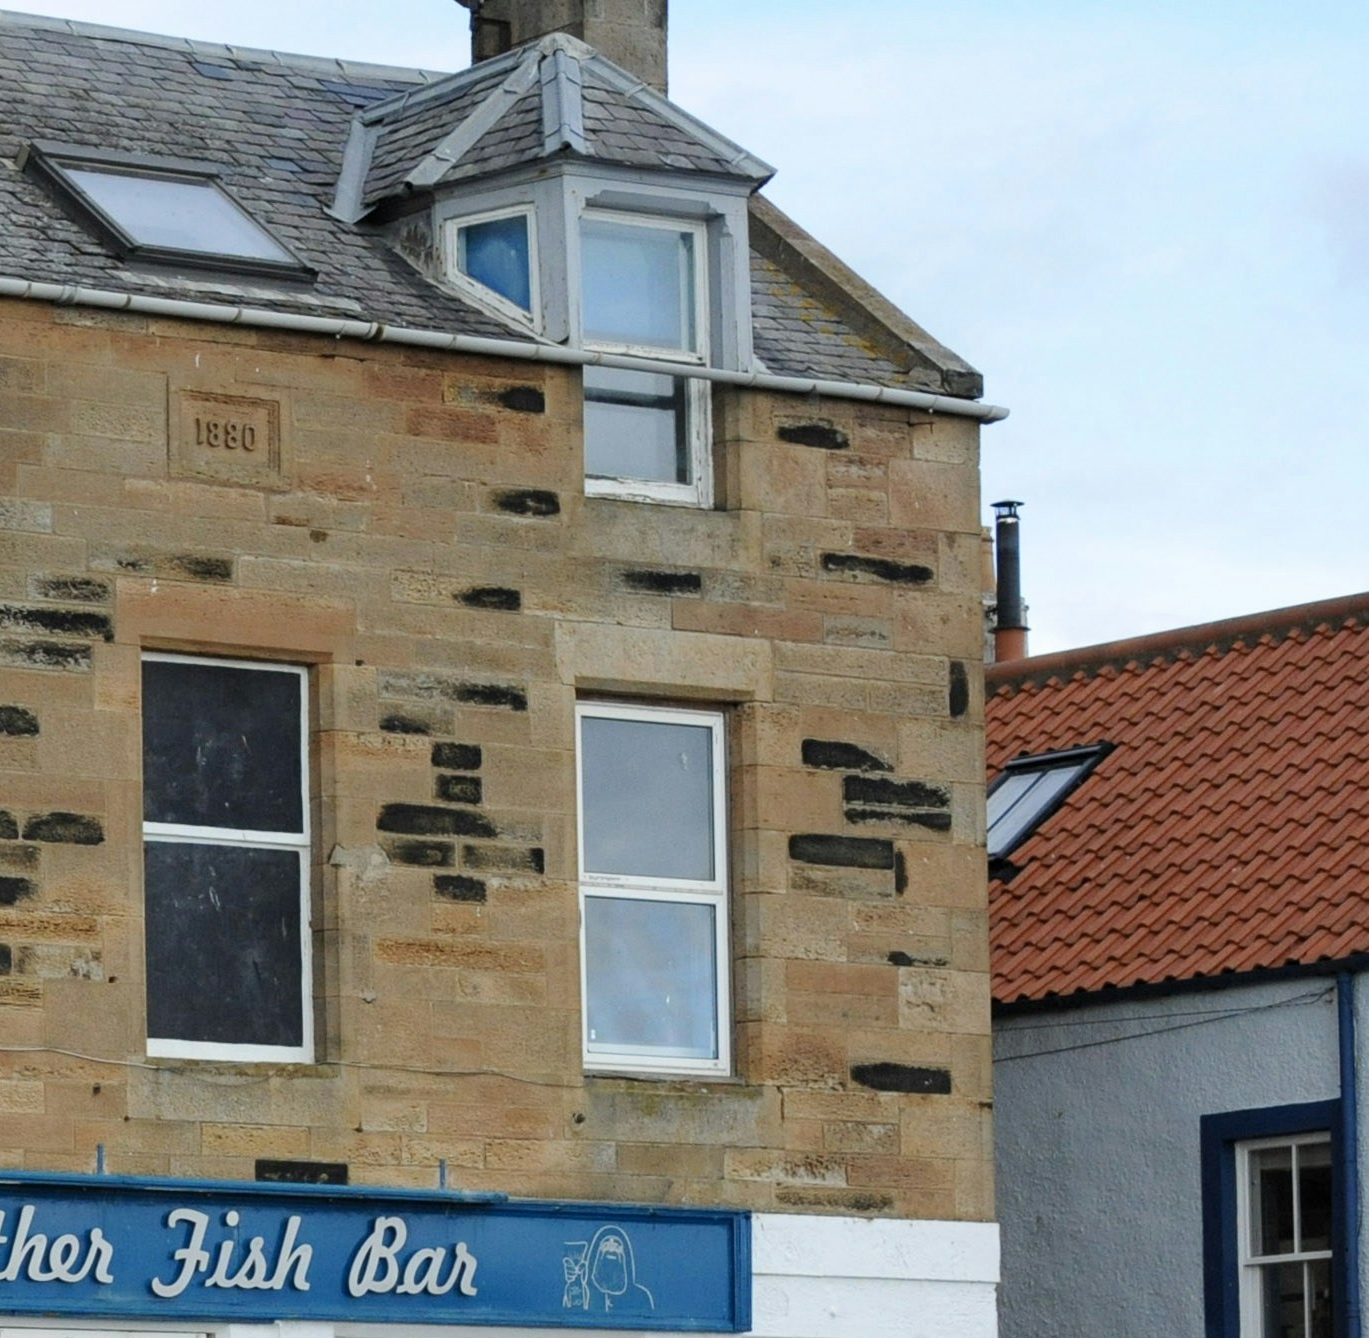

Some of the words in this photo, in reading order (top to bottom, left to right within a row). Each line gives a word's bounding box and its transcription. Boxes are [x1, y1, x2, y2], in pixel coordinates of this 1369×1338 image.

[195, 418, 255, 451] 1880
[151, 1208, 313, 1298] Fish
[348, 1216, 478, 1297] Bar
